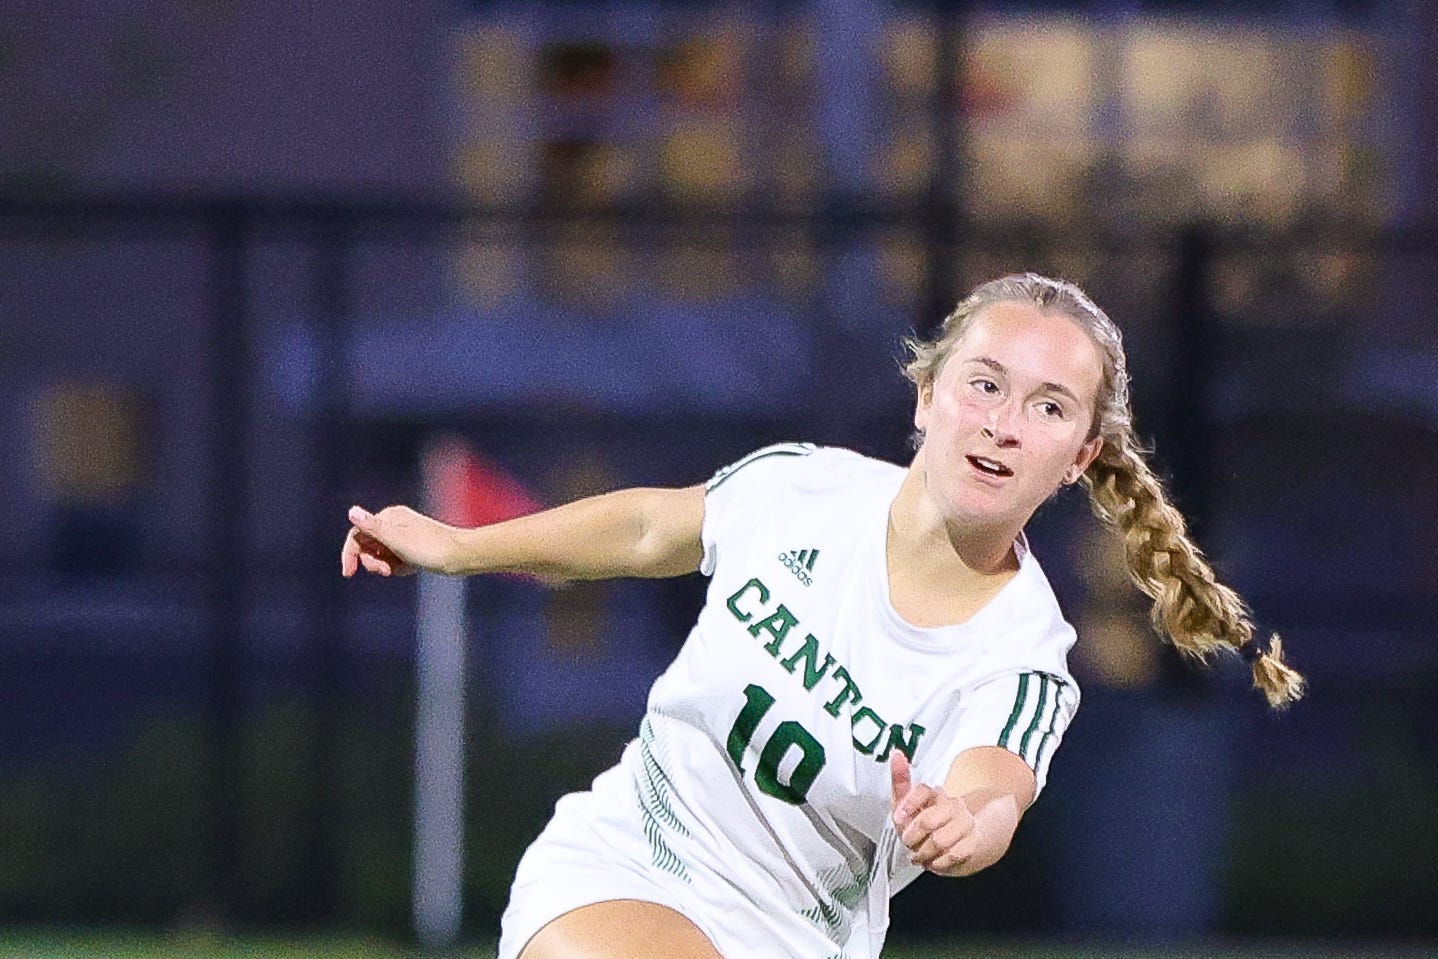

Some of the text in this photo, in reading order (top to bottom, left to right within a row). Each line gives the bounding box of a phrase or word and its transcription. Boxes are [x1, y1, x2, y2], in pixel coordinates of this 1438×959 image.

[778, 551, 813, 587] adidas
[726, 577, 925, 763] CANTON
[726, 683, 826, 806] 10
